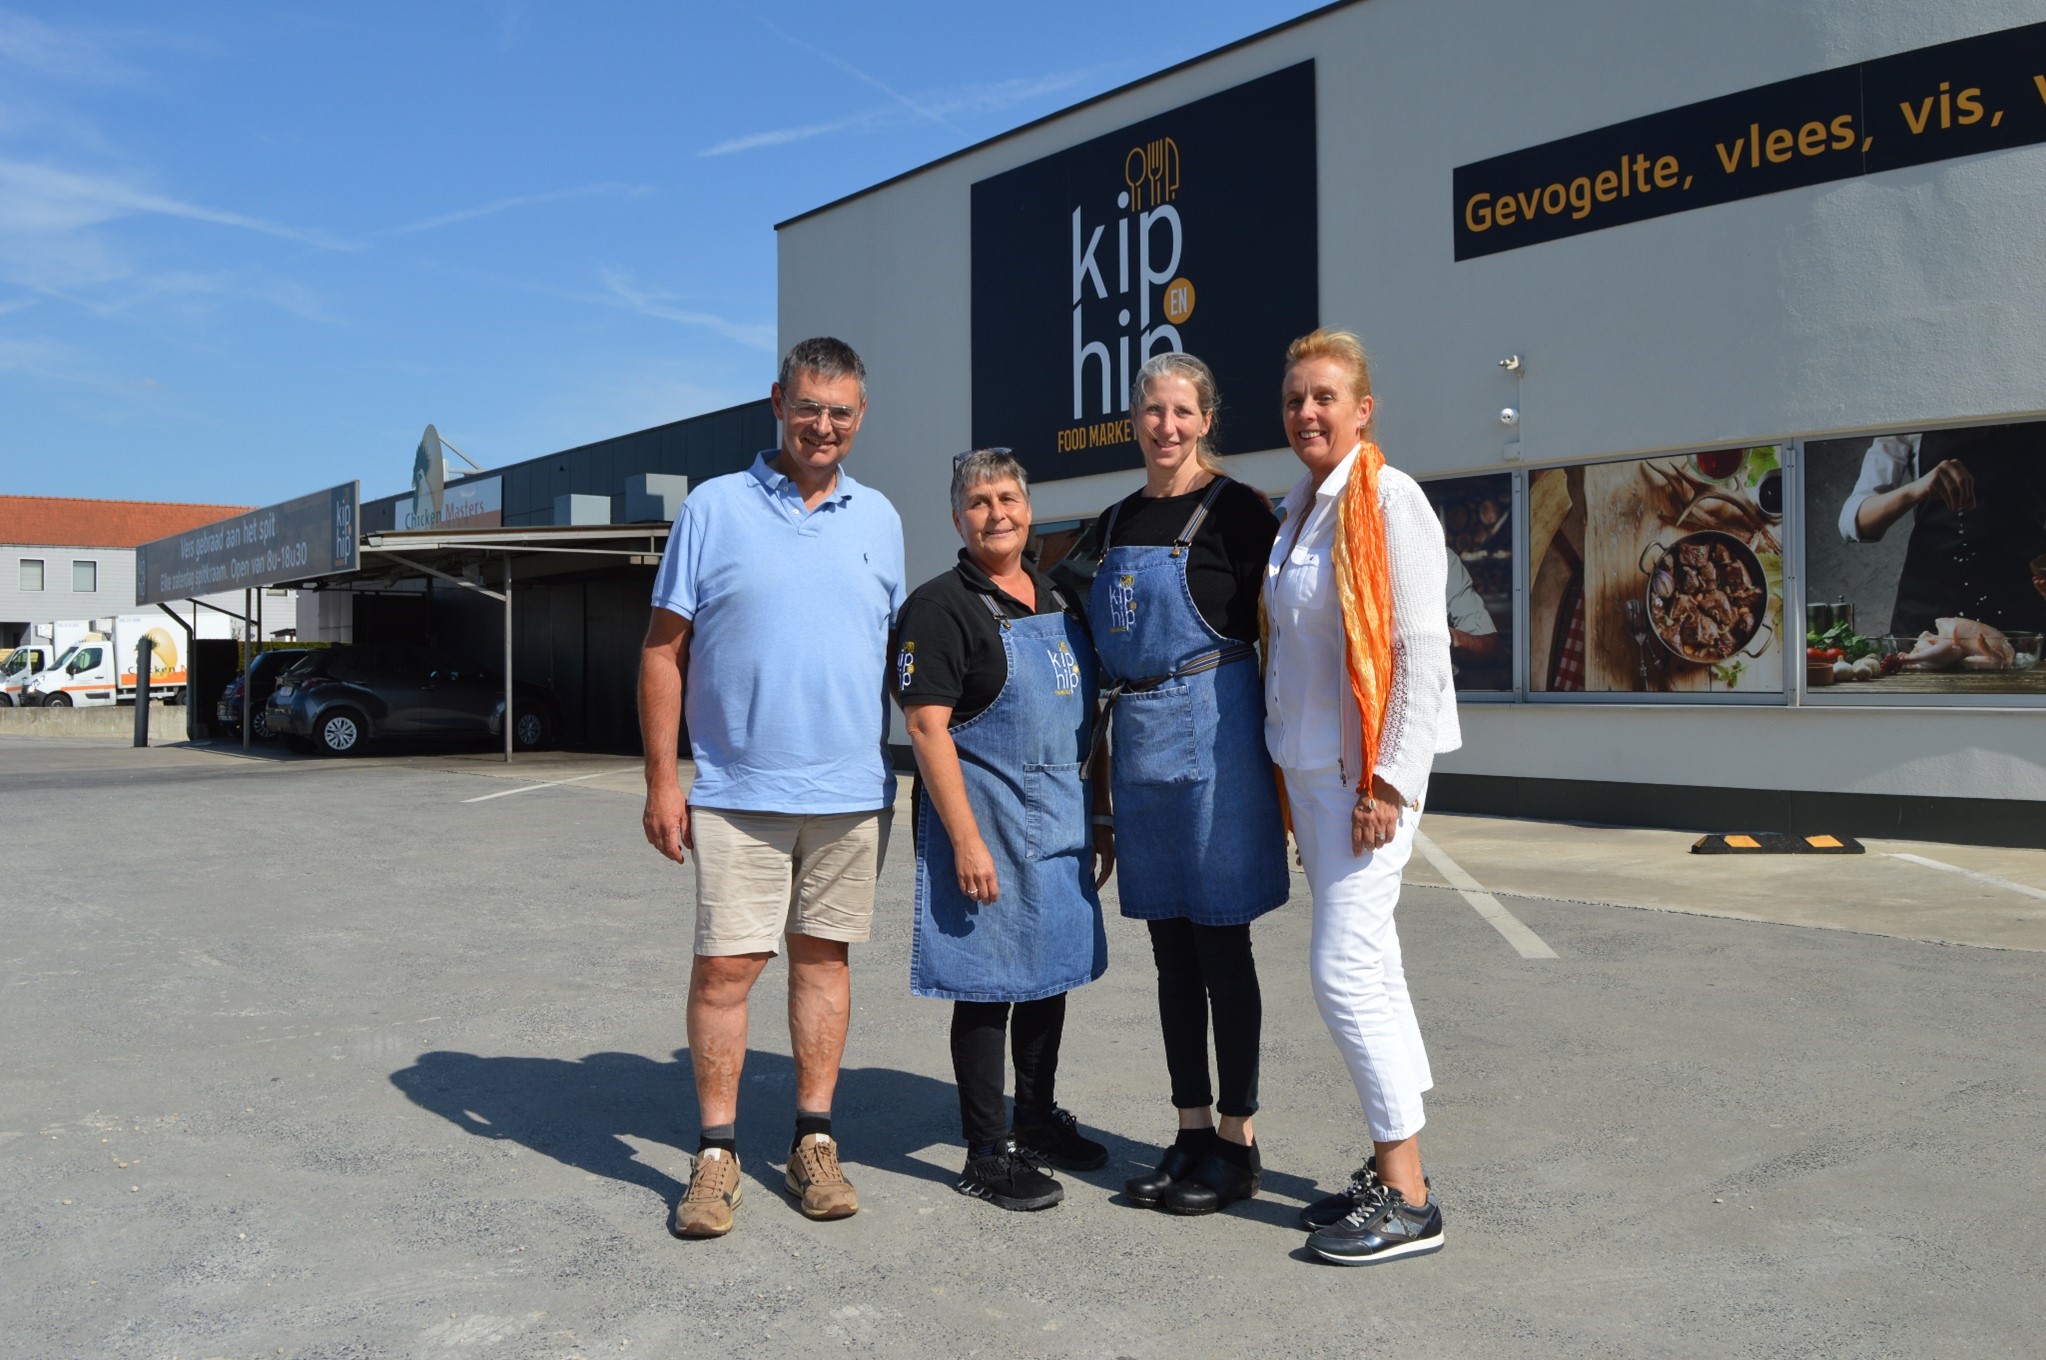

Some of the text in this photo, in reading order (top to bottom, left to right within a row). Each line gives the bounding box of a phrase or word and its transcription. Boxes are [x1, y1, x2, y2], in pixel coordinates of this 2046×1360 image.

[1465, 153, 1694, 233] Gevogelte,
[1715, 114, 1874, 175] vlees,
[1899, 81, 2004, 136] vis,
[1072, 191, 1183, 331] kip
[1170, 286, 1188, 316] EN
[1057, 427, 1087, 453] FOOD
[336, 498, 351, 536] kip
[404, 501, 485, 530] Chicken Masters
[181, 511, 276, 562] Vers gebraad aan het spit
[336, 527, 351, 565] hip
[231, 558, 250, 583] Open
[251, 556, 265, 575] van
[267, 541, 308, 572] 8u-18u30
[1109, 582, 1134, 610] kip
[1046, 648, 1075, 674] kip
[1055, 667, 1079, 694] hip
